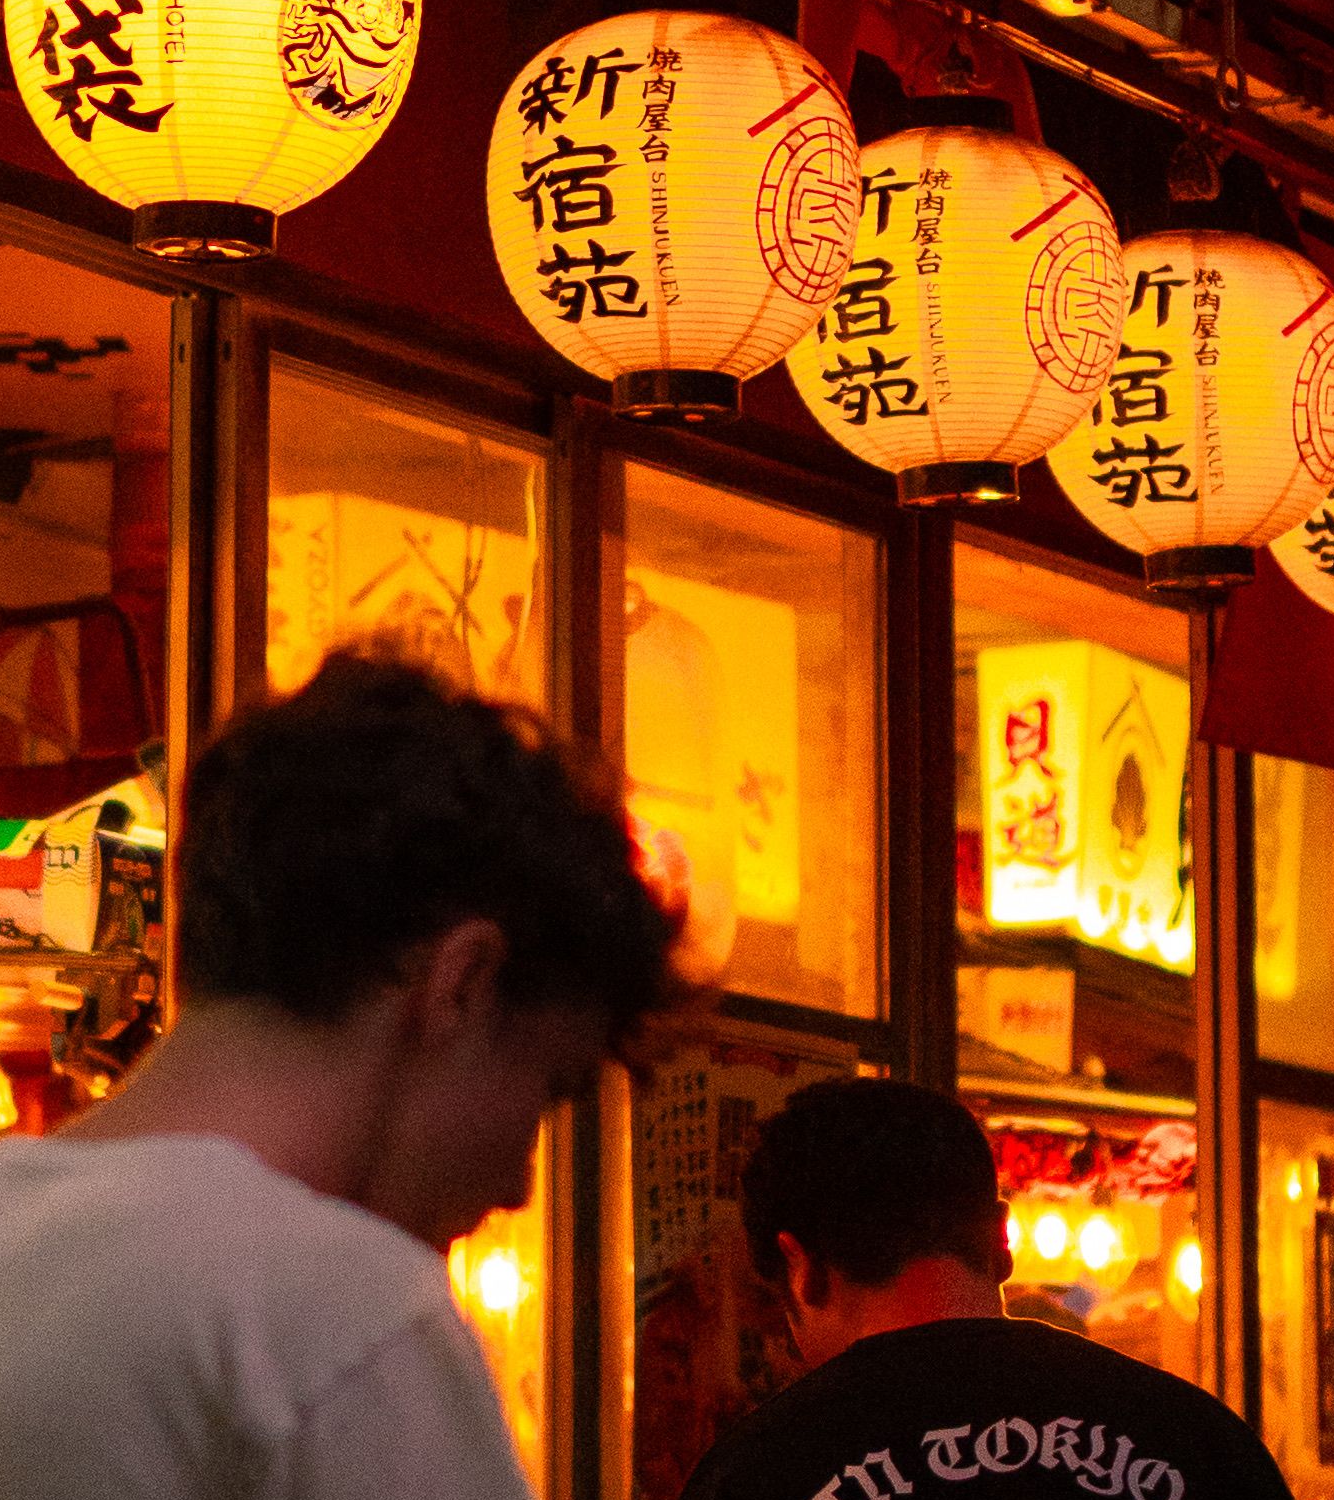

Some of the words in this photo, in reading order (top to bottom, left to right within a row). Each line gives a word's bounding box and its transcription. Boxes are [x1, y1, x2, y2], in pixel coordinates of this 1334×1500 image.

[636, 45, 684, 164] 焼肉屋台
[512, 46, 648, 324] 新宿苑
[650, 170, 683, 307] SHINJUKUEN
[910, 166, 954, 276] 焼肉屋台
[1192, 266, 1227, 368] 焼肉屋台
